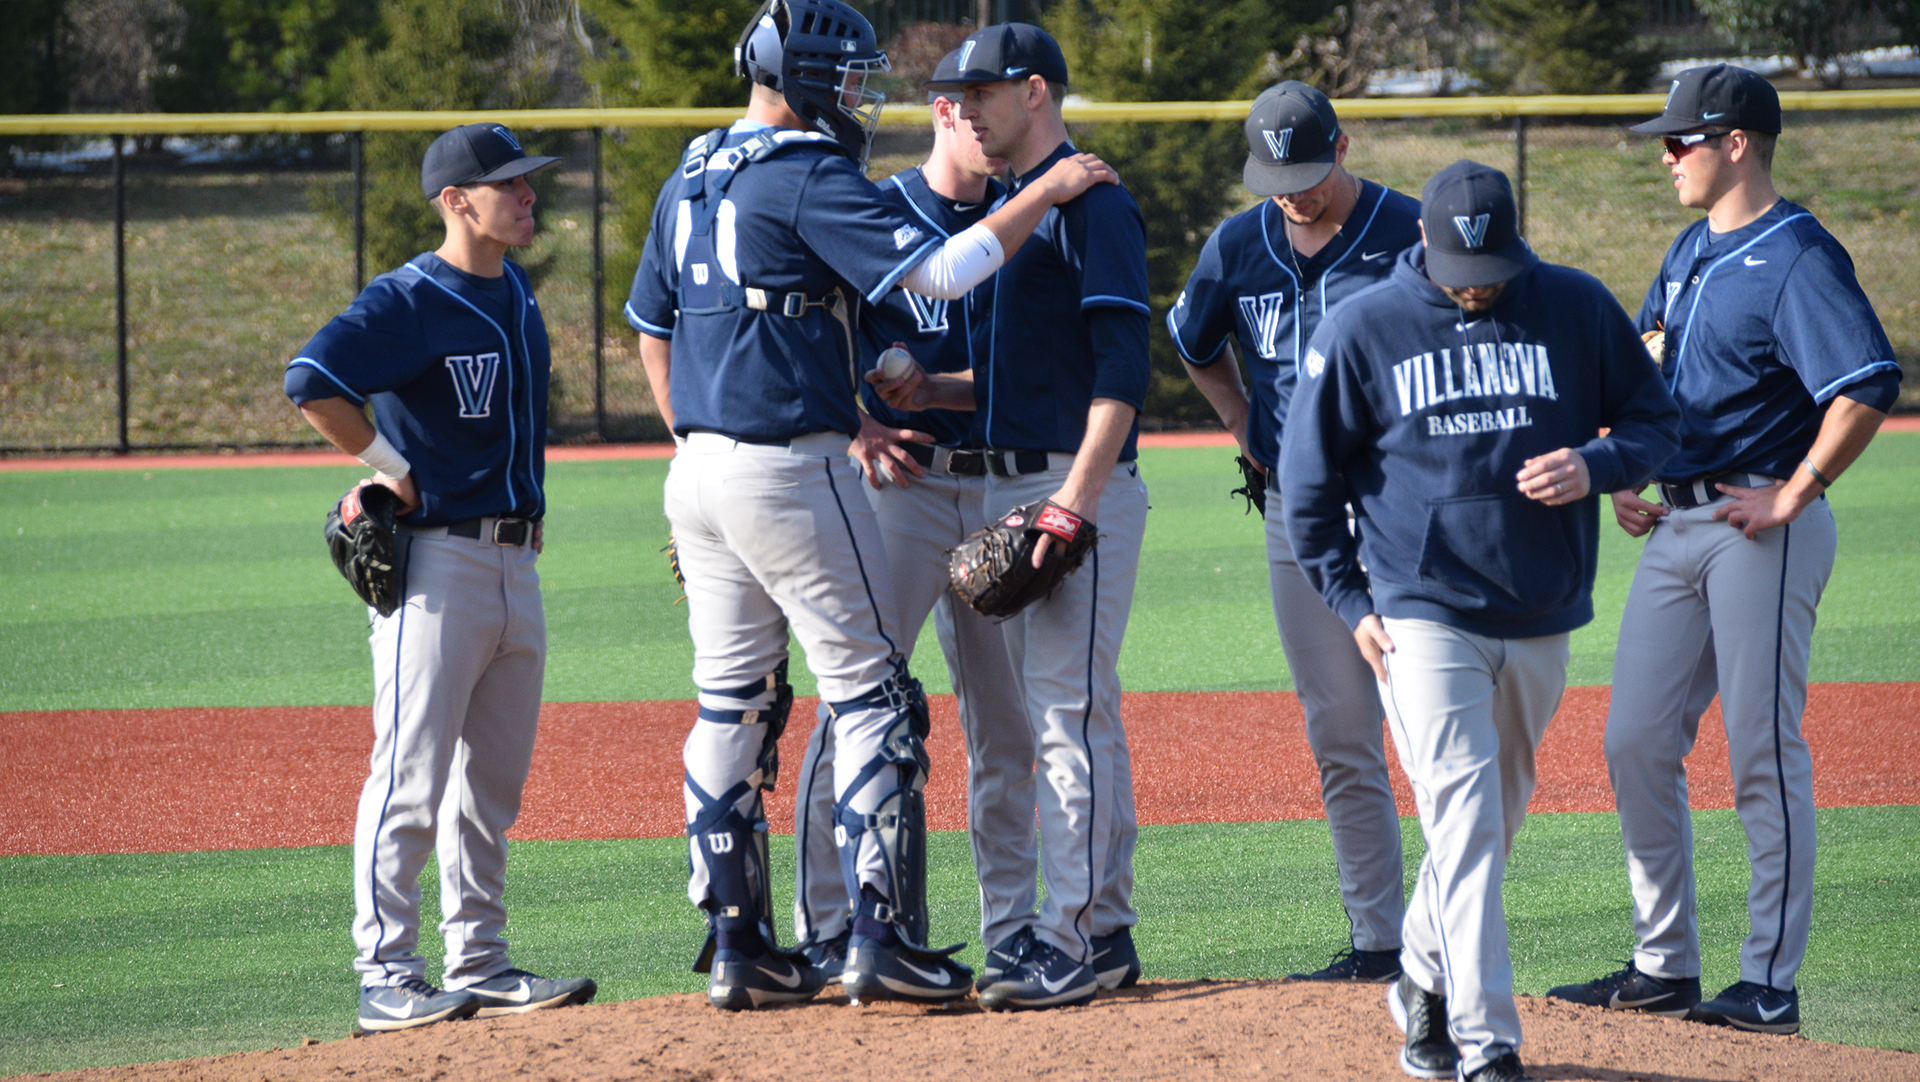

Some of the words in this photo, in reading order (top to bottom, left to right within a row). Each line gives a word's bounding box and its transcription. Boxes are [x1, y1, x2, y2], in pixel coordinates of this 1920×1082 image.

[1263, 127, 1293, 159] V
[1454, 213, 1490, 248] V
[1239, 292, 1283, 359] V
[445, 352, 500, 418] V
[1393, 342, 1558, 416] VILLANOVA
[1427, 406, 1532, 436] BASEBALL
